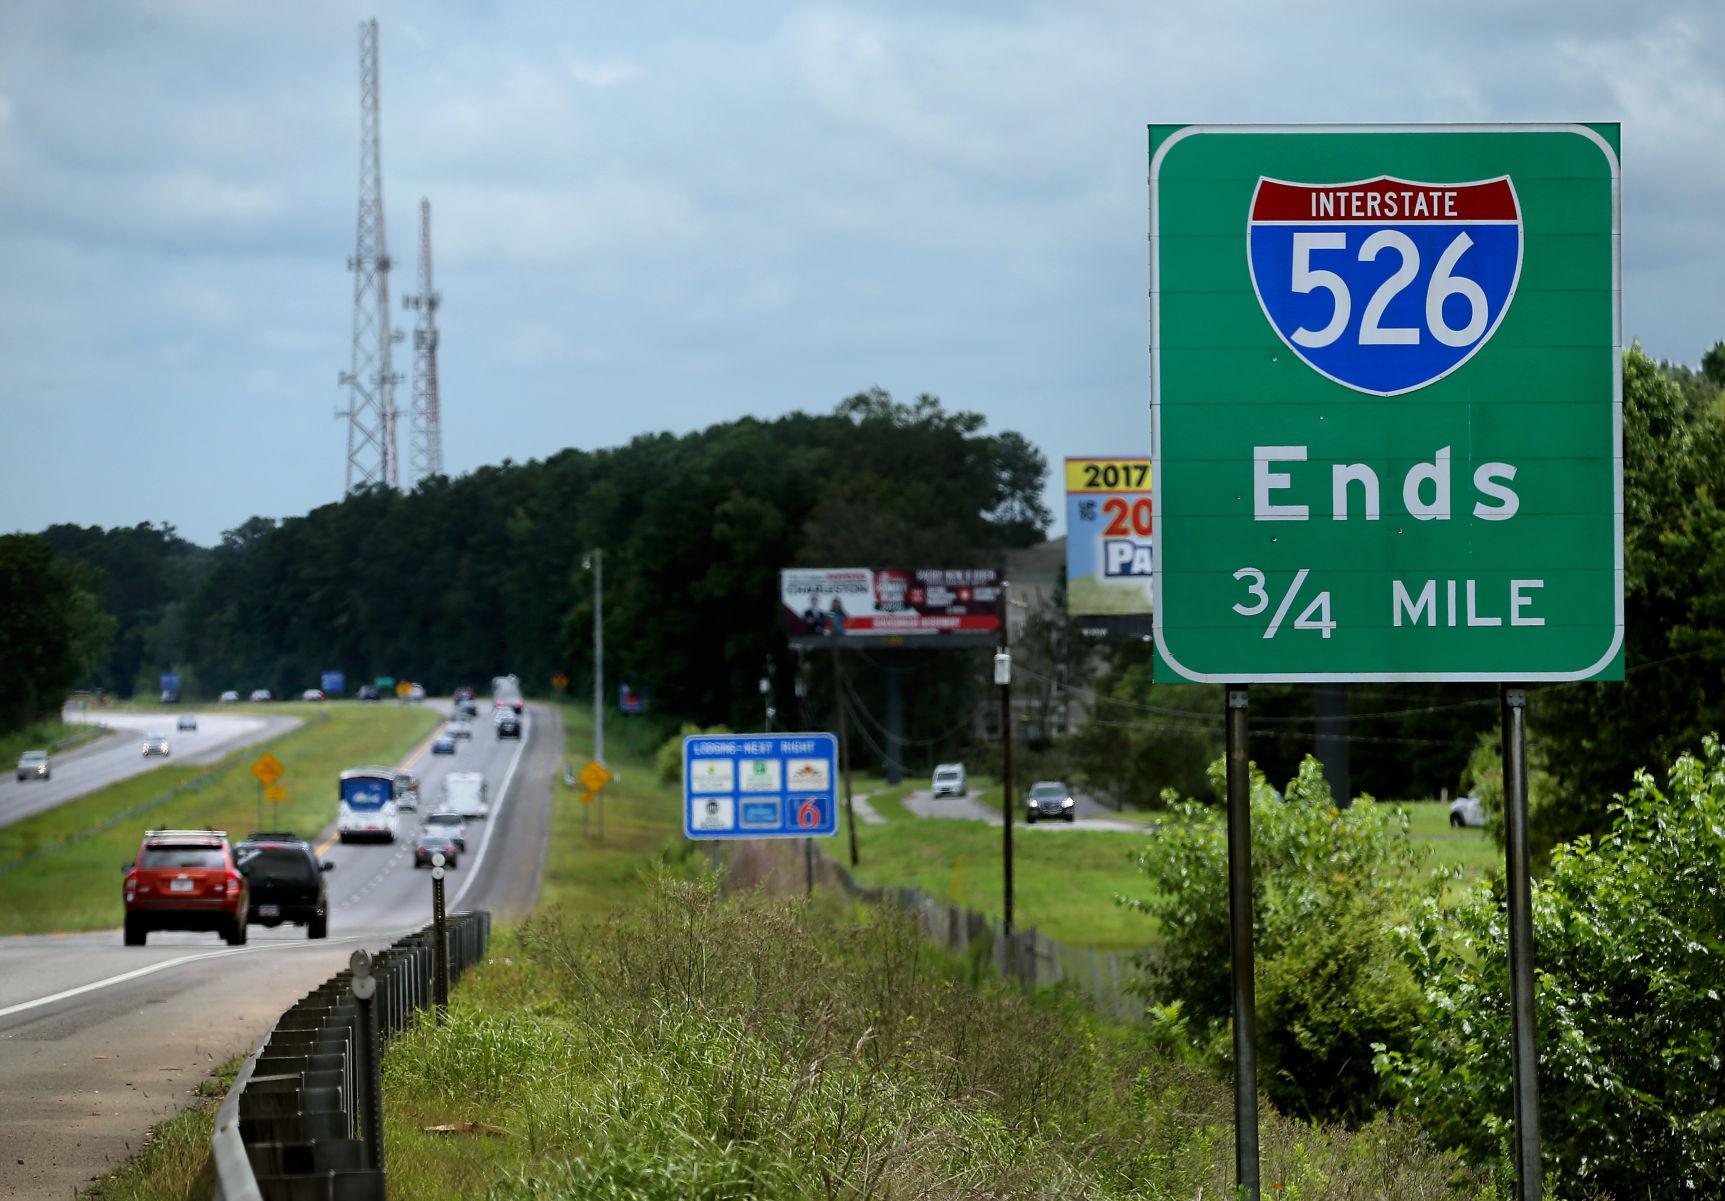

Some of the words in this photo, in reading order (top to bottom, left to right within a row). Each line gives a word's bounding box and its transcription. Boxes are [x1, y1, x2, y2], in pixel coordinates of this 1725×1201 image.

[1310, 191, 1458, 218] INTERSTATE
[1291, 230, 1489, 348] 526
[1084, 464, 1150, 487] 2017
[1253, 446, 1520, 522] Ends
[1232, 567, 1337, 639] 3/4
[1393, 580, 1546, 628] MILE
[797, 796, 821, 828] 6
